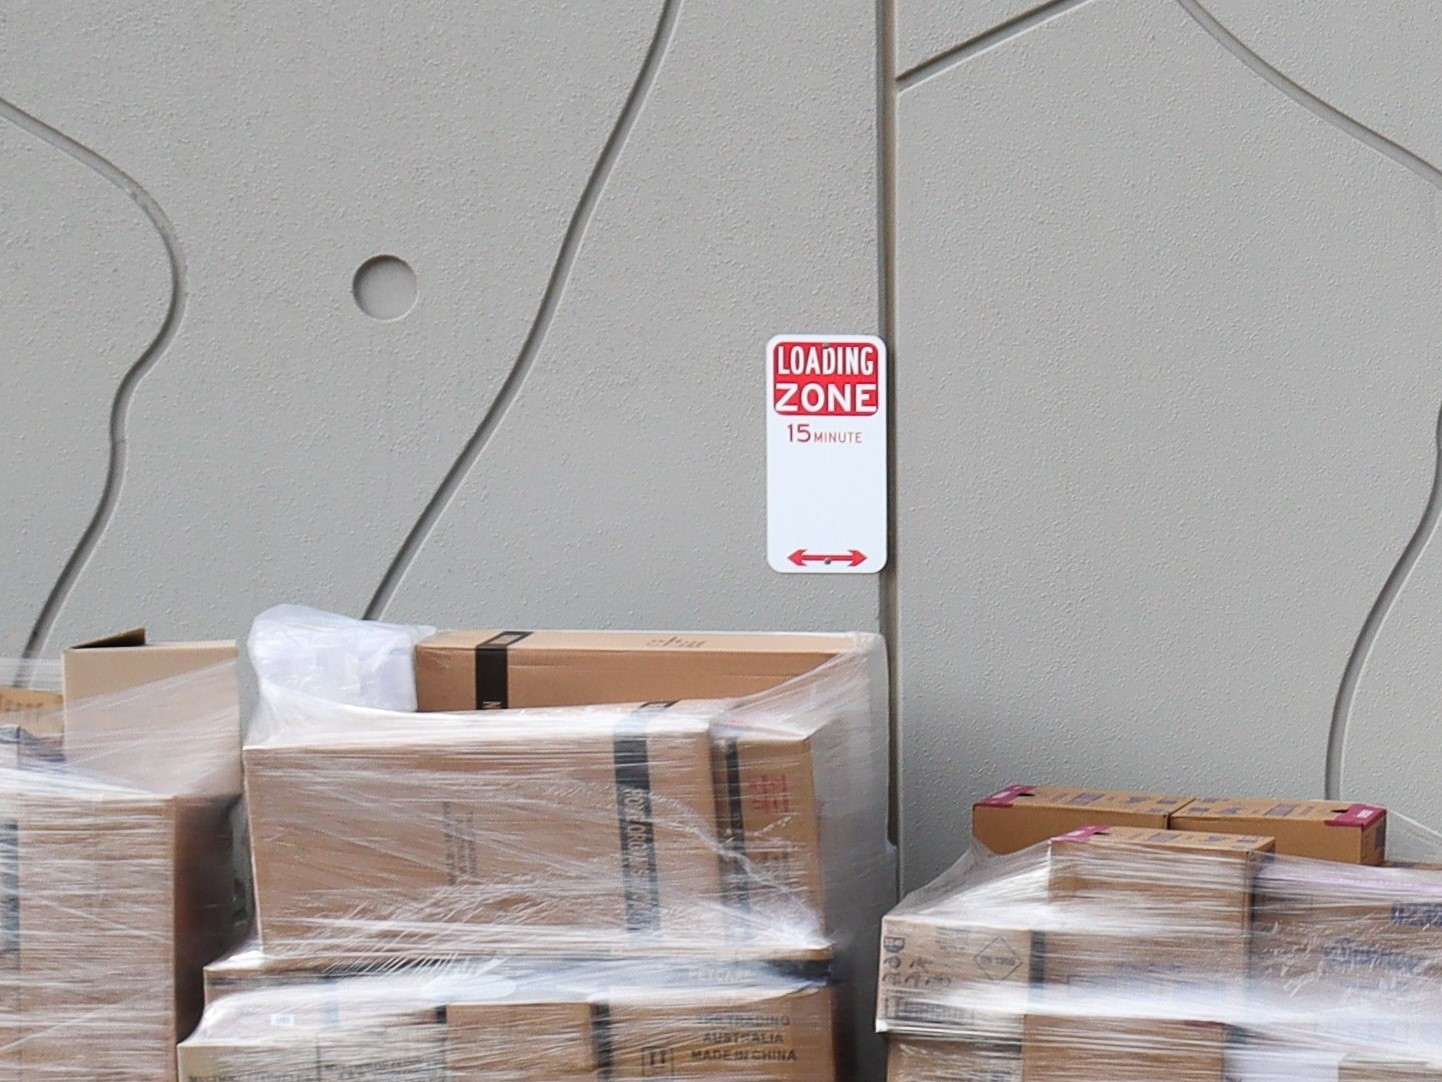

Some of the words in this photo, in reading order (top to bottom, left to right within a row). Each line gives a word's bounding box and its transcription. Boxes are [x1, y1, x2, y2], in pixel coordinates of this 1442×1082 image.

[777, 346, 874, 376] LOADING
[775, 383, 877, 412] ZONE
[787, 424, 811, 443] 15
[814, 432, 862, 443] MINUTE
